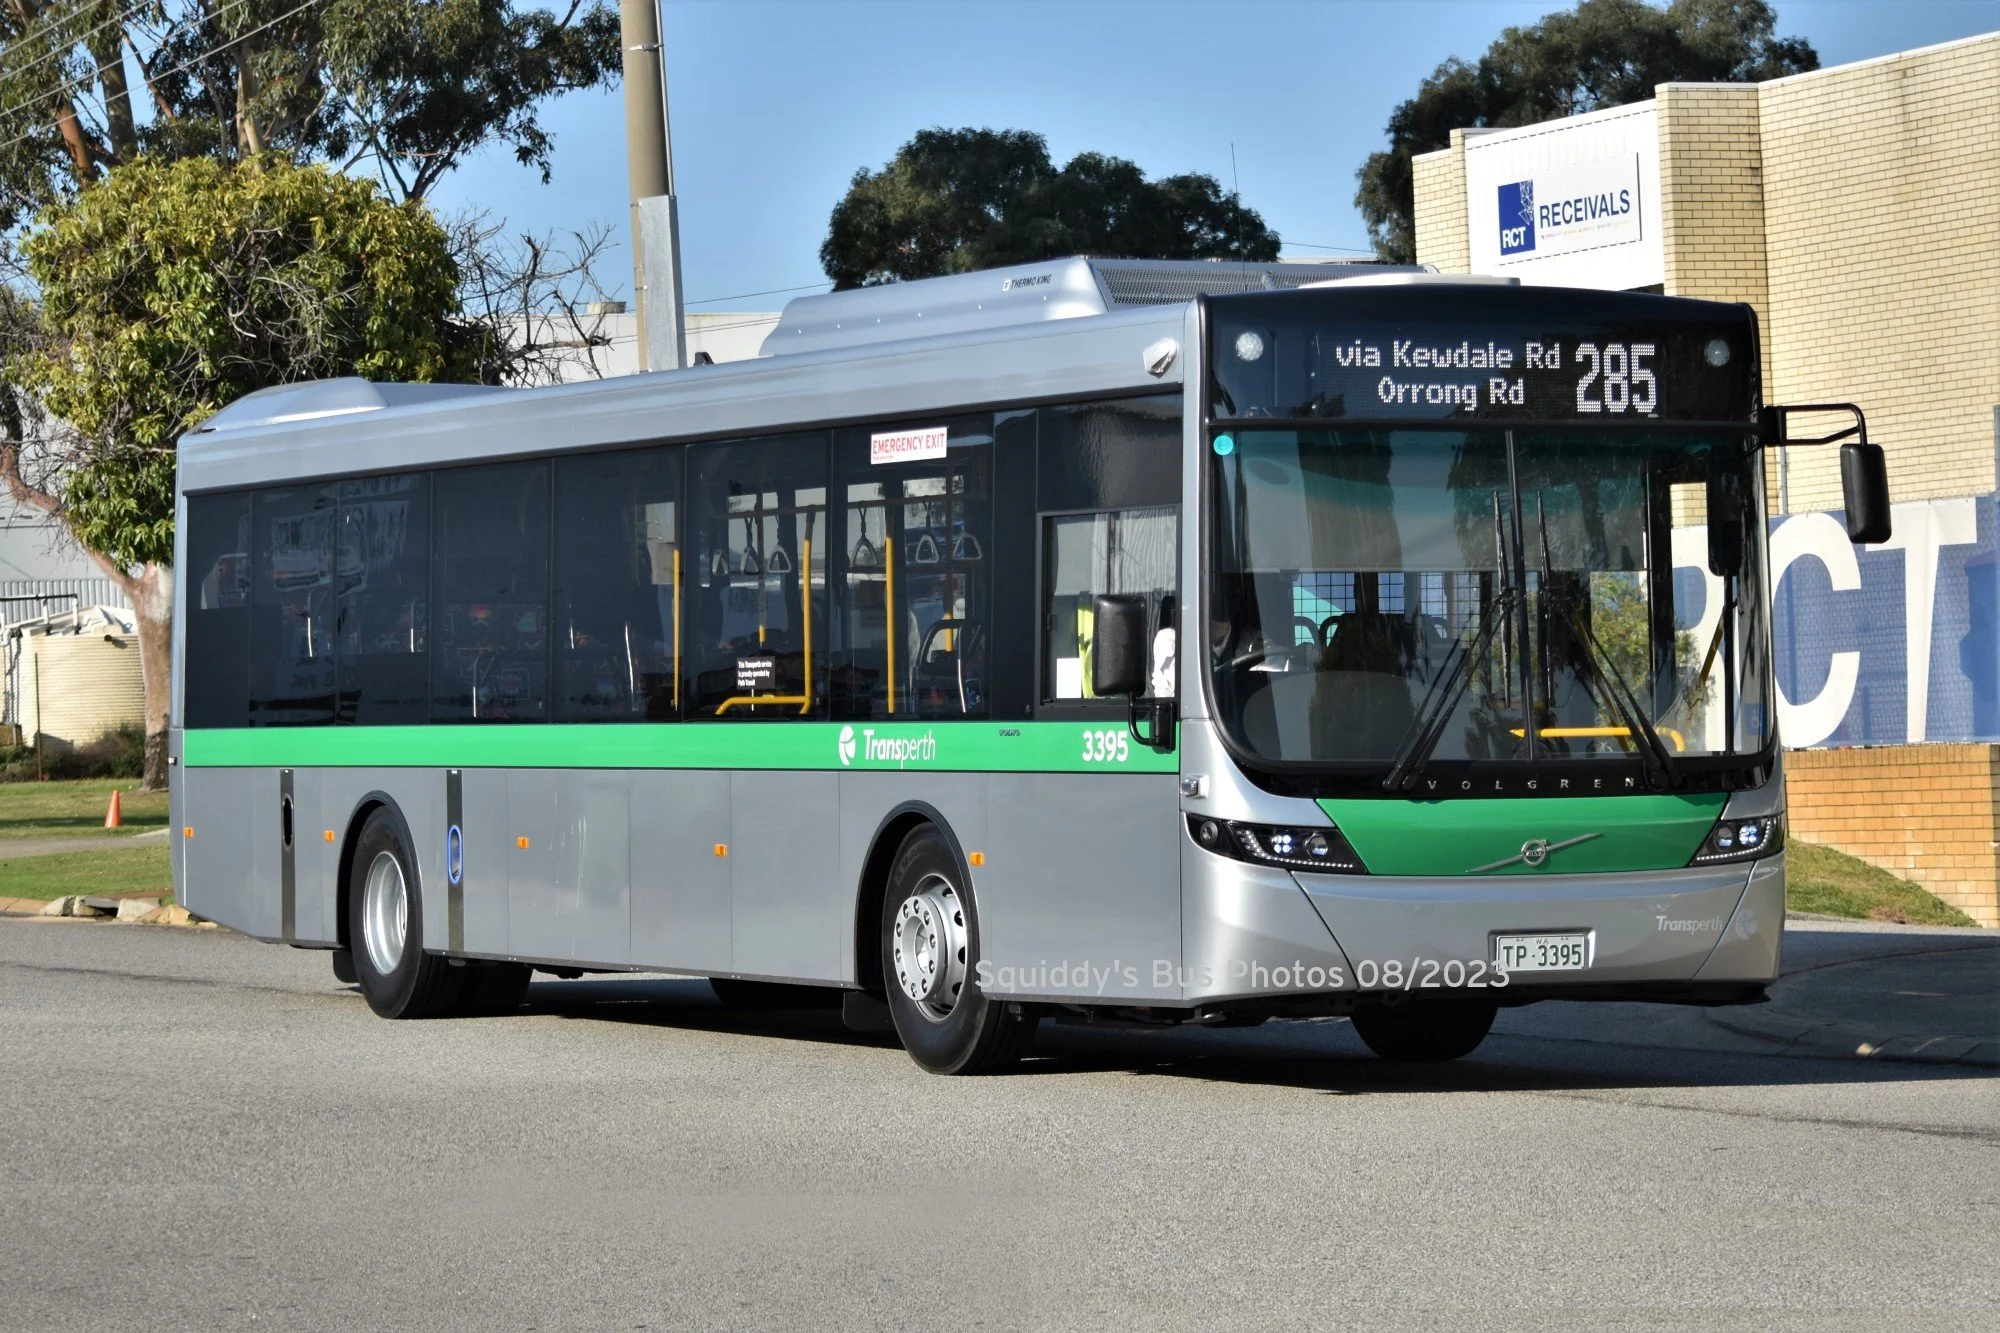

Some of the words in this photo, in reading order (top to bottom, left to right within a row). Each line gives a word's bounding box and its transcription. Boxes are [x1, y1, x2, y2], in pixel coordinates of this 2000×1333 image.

[1540, 189, 1631, 229] RECEIVALS
[1502, 226, 1527, 249] RCT
[1011, 277, 1036, 288] THERMO
[1036, 274, 1052, 284] KING
[1335, 340, 1380, 367] via
[1393, 340, 1513, 368] Kewdale
[1525, 342, 1560, 369] Rd
[1575, 343, 1657, 413] 285
[1377, 376, 1478, 412] Orrong
[1489, 377, 1524, 405] Rd
[873, 436, 922, 454] EMERGENCY
[926, 433, 945, 449] EXIT
[864, 730, 936, 769] Transperth
[1082, 730, 1129, 762] 3395
[1428, 777, 1635, 789] VOLGREN
[1656, 915, 1723, 935] Transperth
